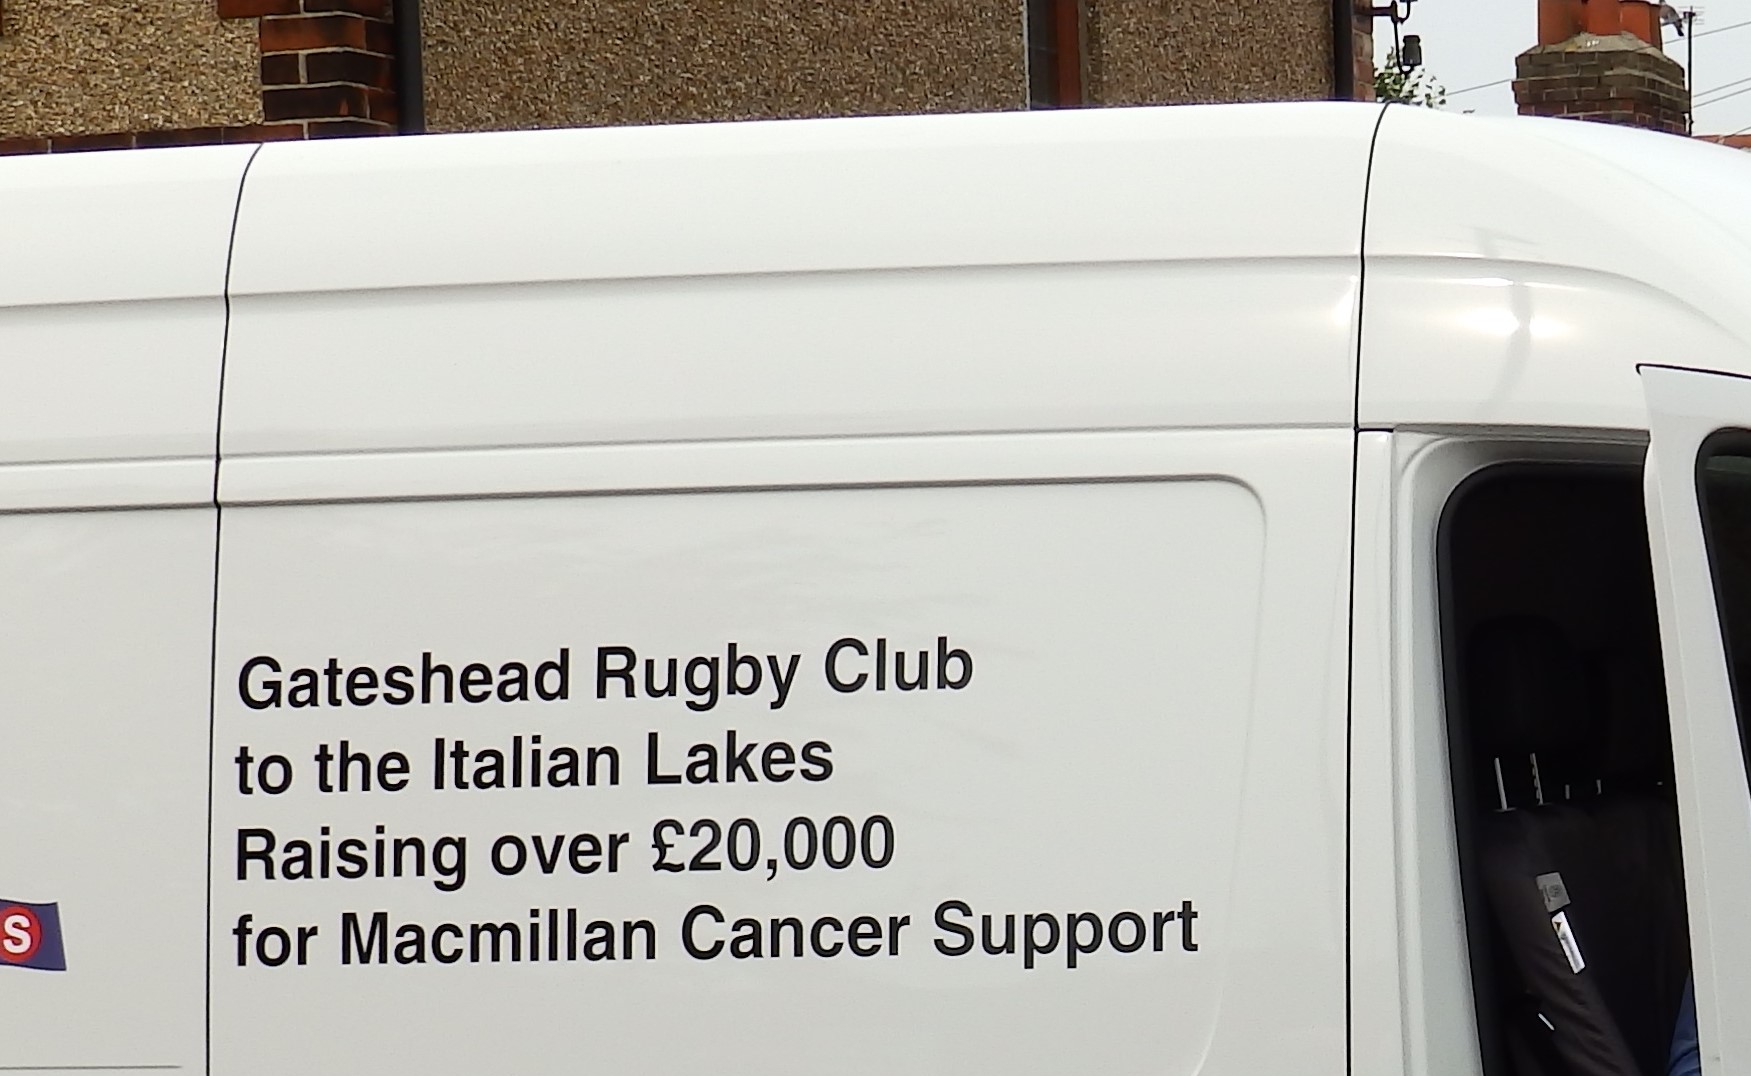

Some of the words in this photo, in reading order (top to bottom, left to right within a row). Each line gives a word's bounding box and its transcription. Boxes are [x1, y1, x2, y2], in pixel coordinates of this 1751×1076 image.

[238, 647, 570, 710] Gateshead
[596, 642, 801, 712] Rugby
[824, 636, 973, 694] Club
[234, 746, 293, 795] to
[314, 740, 410, 793] the
[434, 734, 620, 790] Italian
[647, 729, 834, 785] Lakes
[237, 824, 467, 892] Raising
[491, 832, 630, 876] over
[651, 814, 895, 882] £20,000
[232, 913, 318, 967] for
[341, 908, 656, 965] Macmillan
[681, 904, 911, 961] Cancer
[933, 899, 1199, 970] Support
